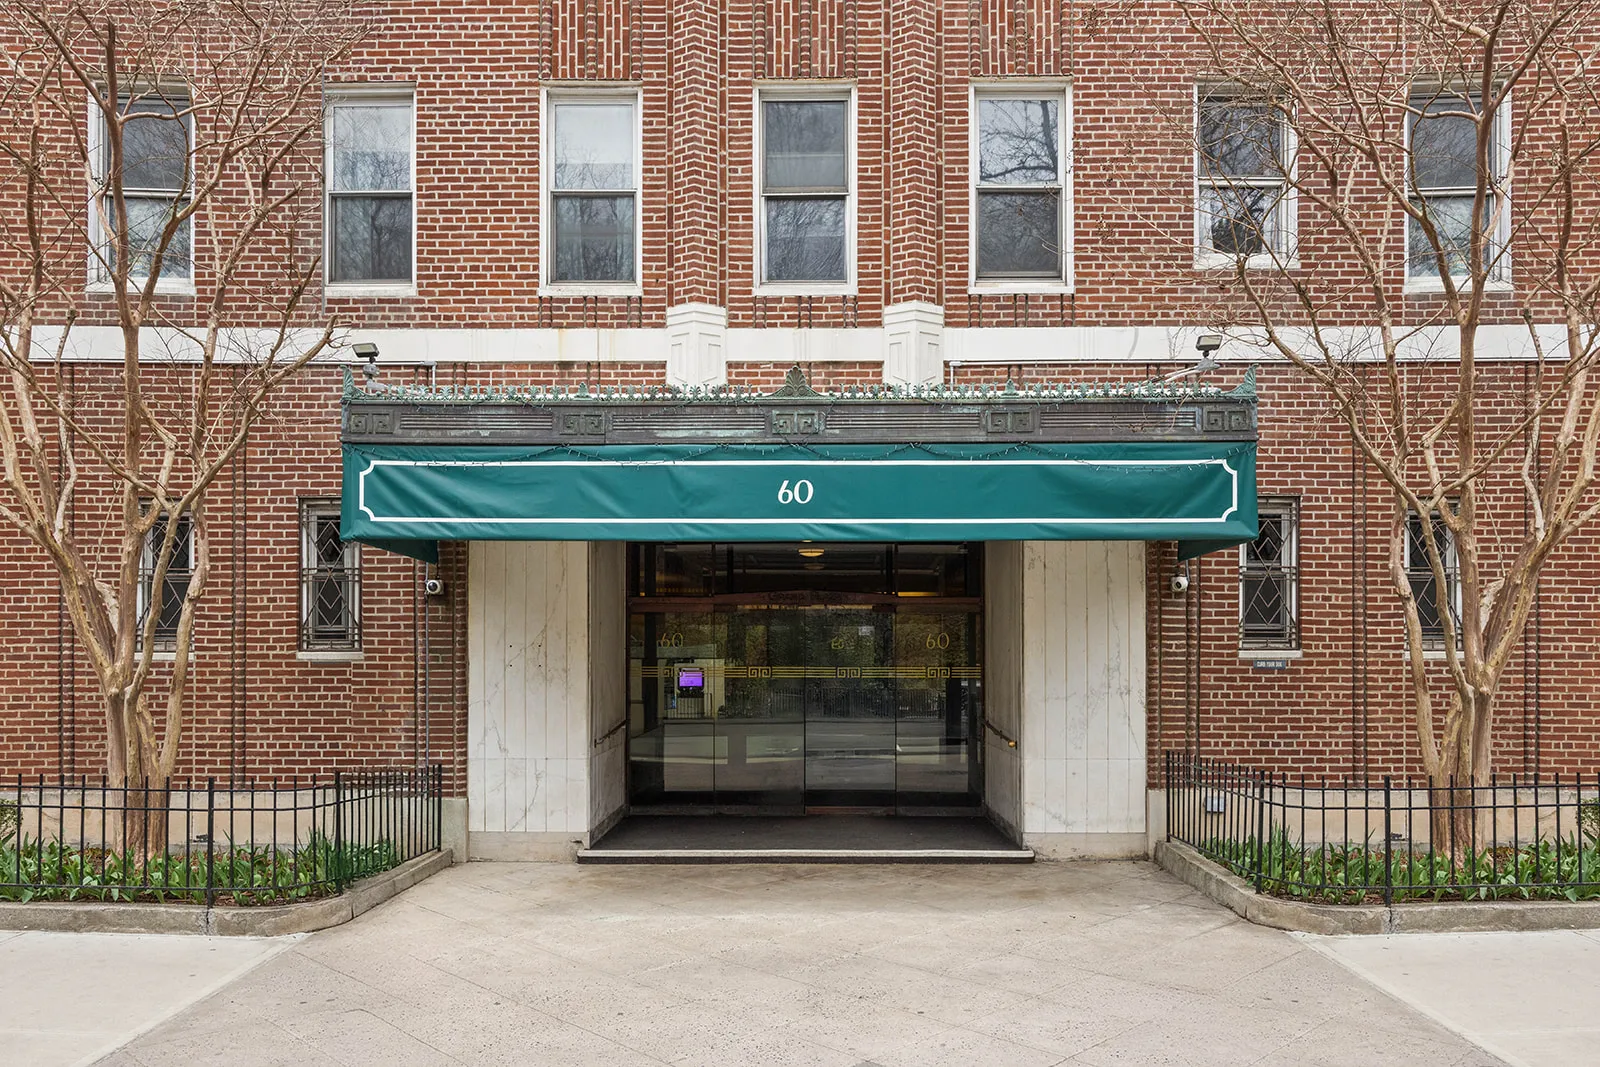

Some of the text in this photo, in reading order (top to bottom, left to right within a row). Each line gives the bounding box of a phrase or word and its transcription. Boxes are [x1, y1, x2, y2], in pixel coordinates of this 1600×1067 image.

[777, 479, 814, 504] 60
[660, 632, 683, 649] 60
[926, 632, 950, 650] 60
